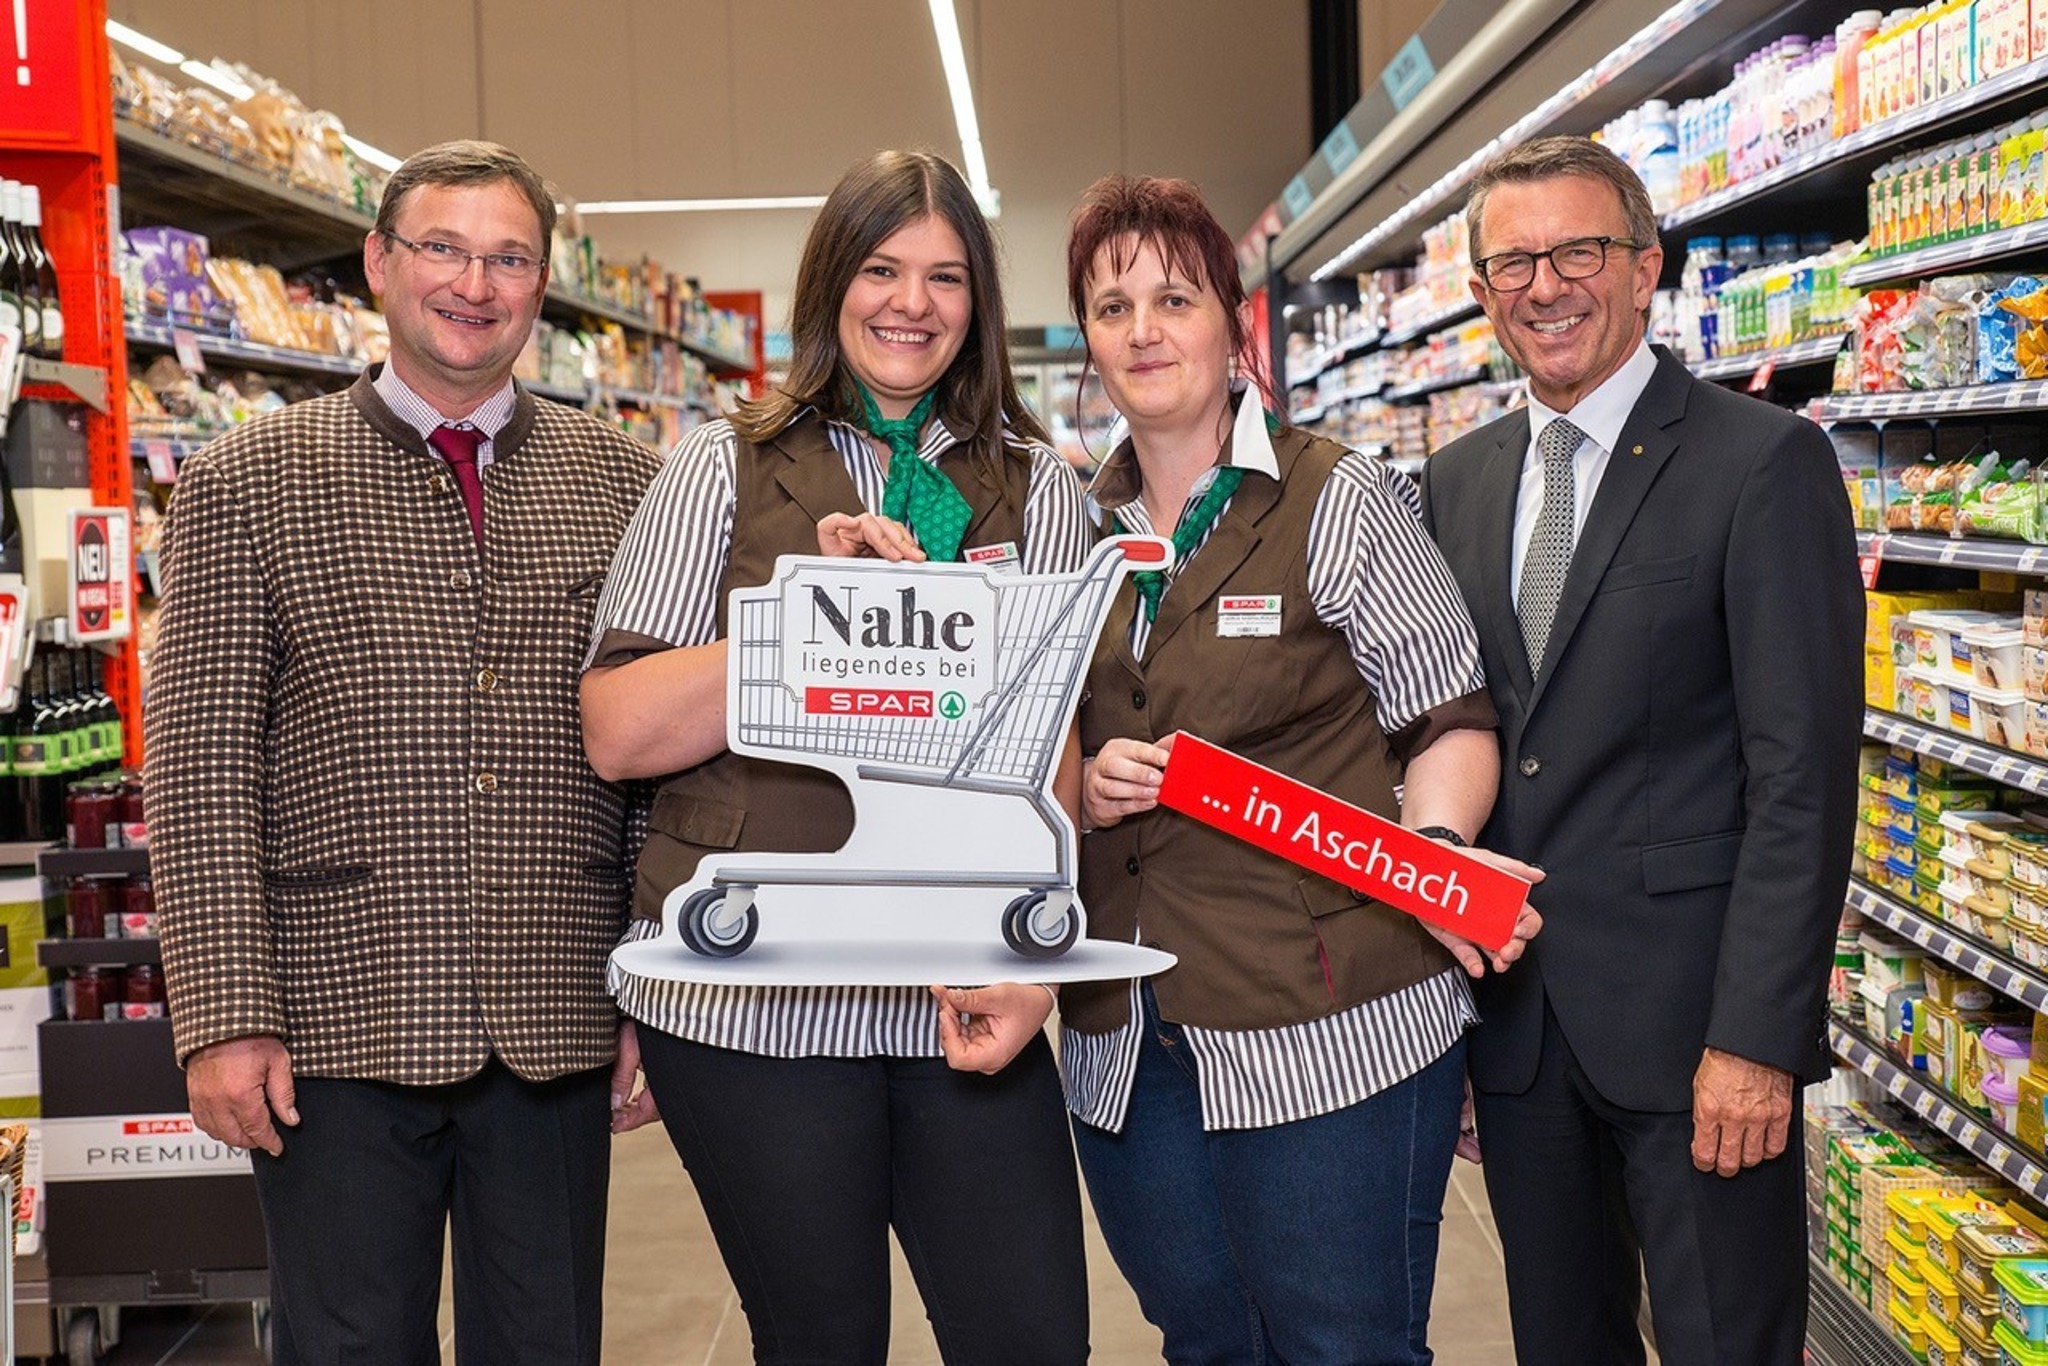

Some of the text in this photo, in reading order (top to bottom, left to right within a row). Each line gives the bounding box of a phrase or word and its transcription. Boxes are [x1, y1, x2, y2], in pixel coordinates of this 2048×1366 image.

[79, 543, 108, 582] NEU
[977, 548, 1005, 559] SPAR
[1232, 599, 1266, 609] SPAR
[801, 584, 976, 652] Nahe
[802, 652, 976, 678] liegendes bei
[829, 692, 931, 714] SPAR
[1242, 785, 1283, 834] in
[1290, 810, 1470, 917] Aschach
[136, 1120, 192, 1134] SPAR
[86, 1144, 250, 1165] PREMIUM
